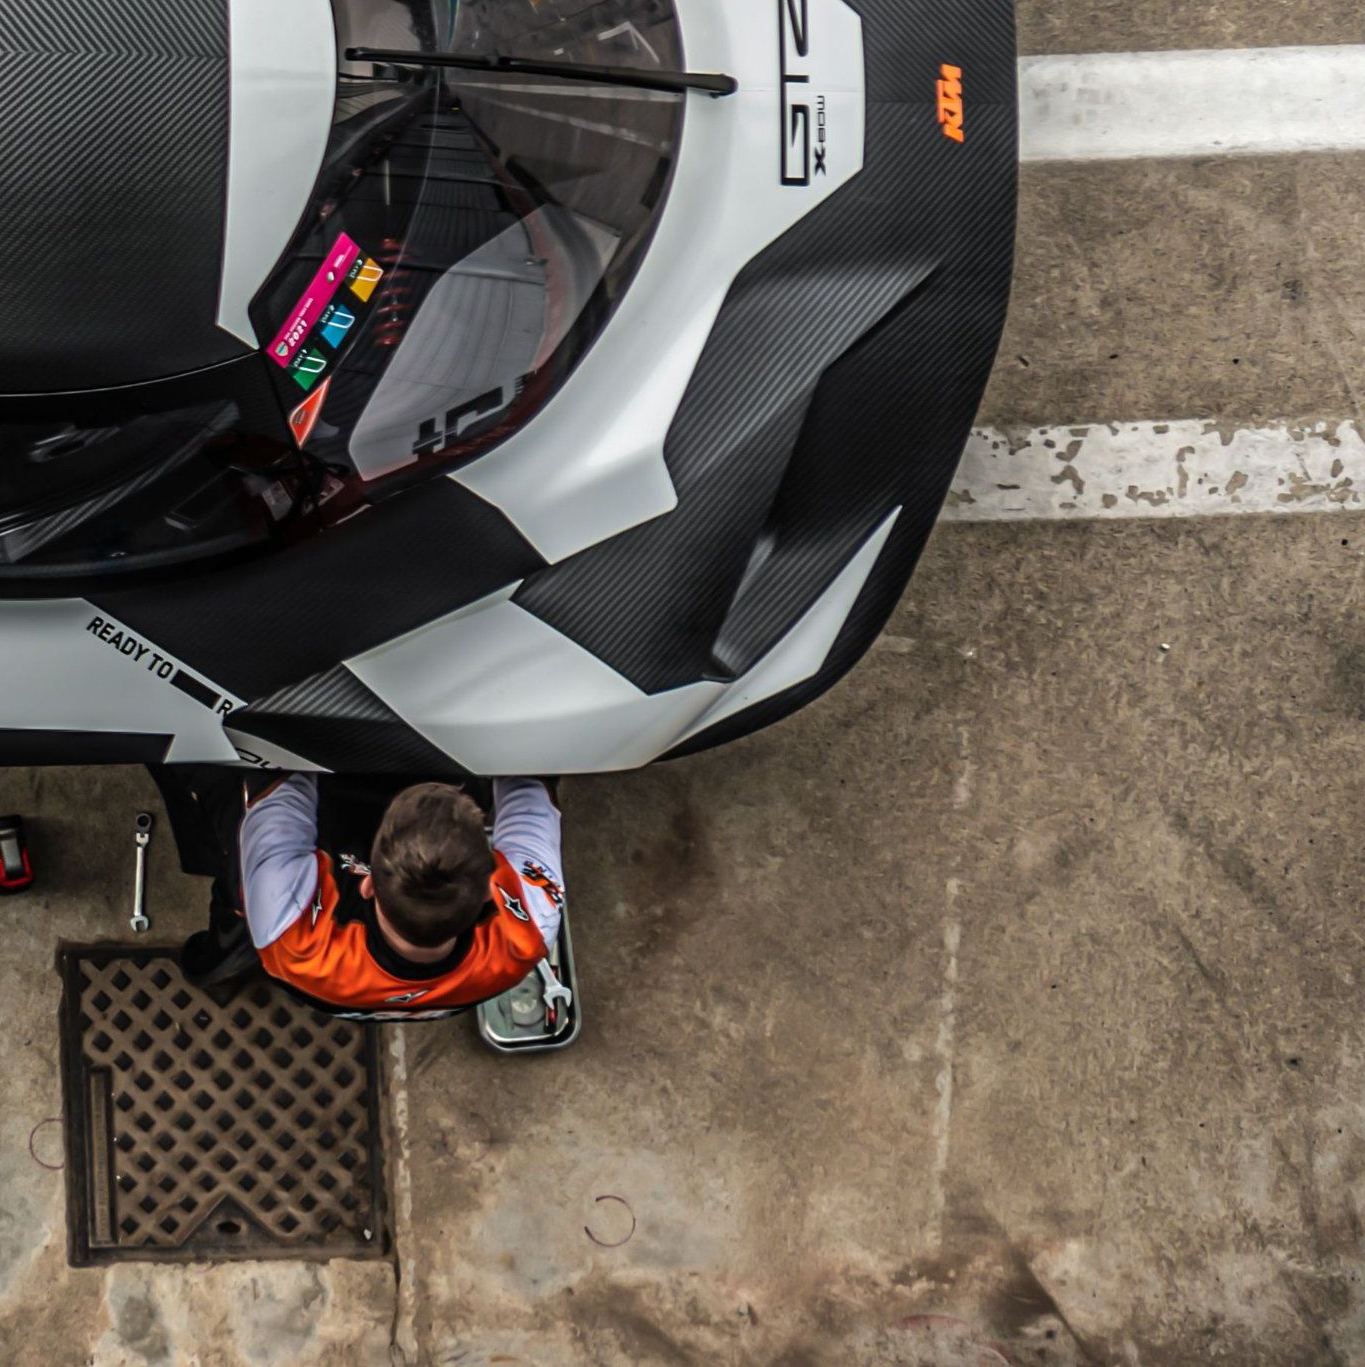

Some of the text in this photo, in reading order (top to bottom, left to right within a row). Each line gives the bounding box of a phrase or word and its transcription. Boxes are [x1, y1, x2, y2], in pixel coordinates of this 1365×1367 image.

[935, 62, 965, 143] KTM
[287, 319, 308, 347] 2021
[86, 616, 174, 679] READY TO
